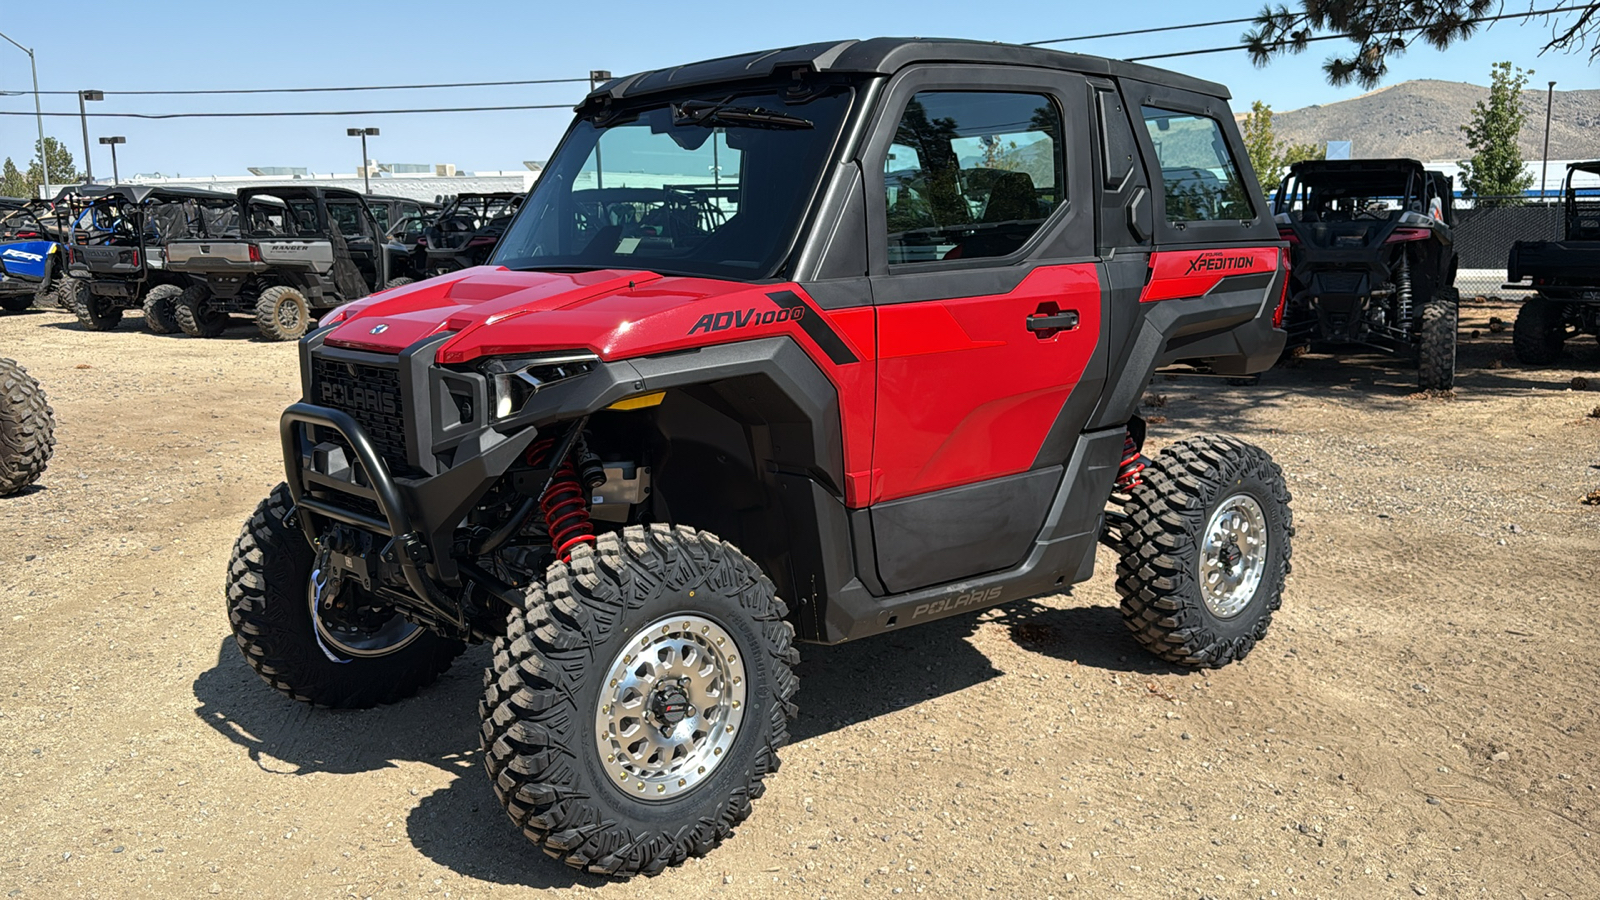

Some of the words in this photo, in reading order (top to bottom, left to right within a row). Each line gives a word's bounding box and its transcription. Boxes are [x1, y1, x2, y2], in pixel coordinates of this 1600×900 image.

[3, 248, 44, 262] RZR
[1184, 253, 1254, 276] XPEDITION
[321, 381, 397, 414] POLARIS
[911, 585, 1004, 619] POLARIS
